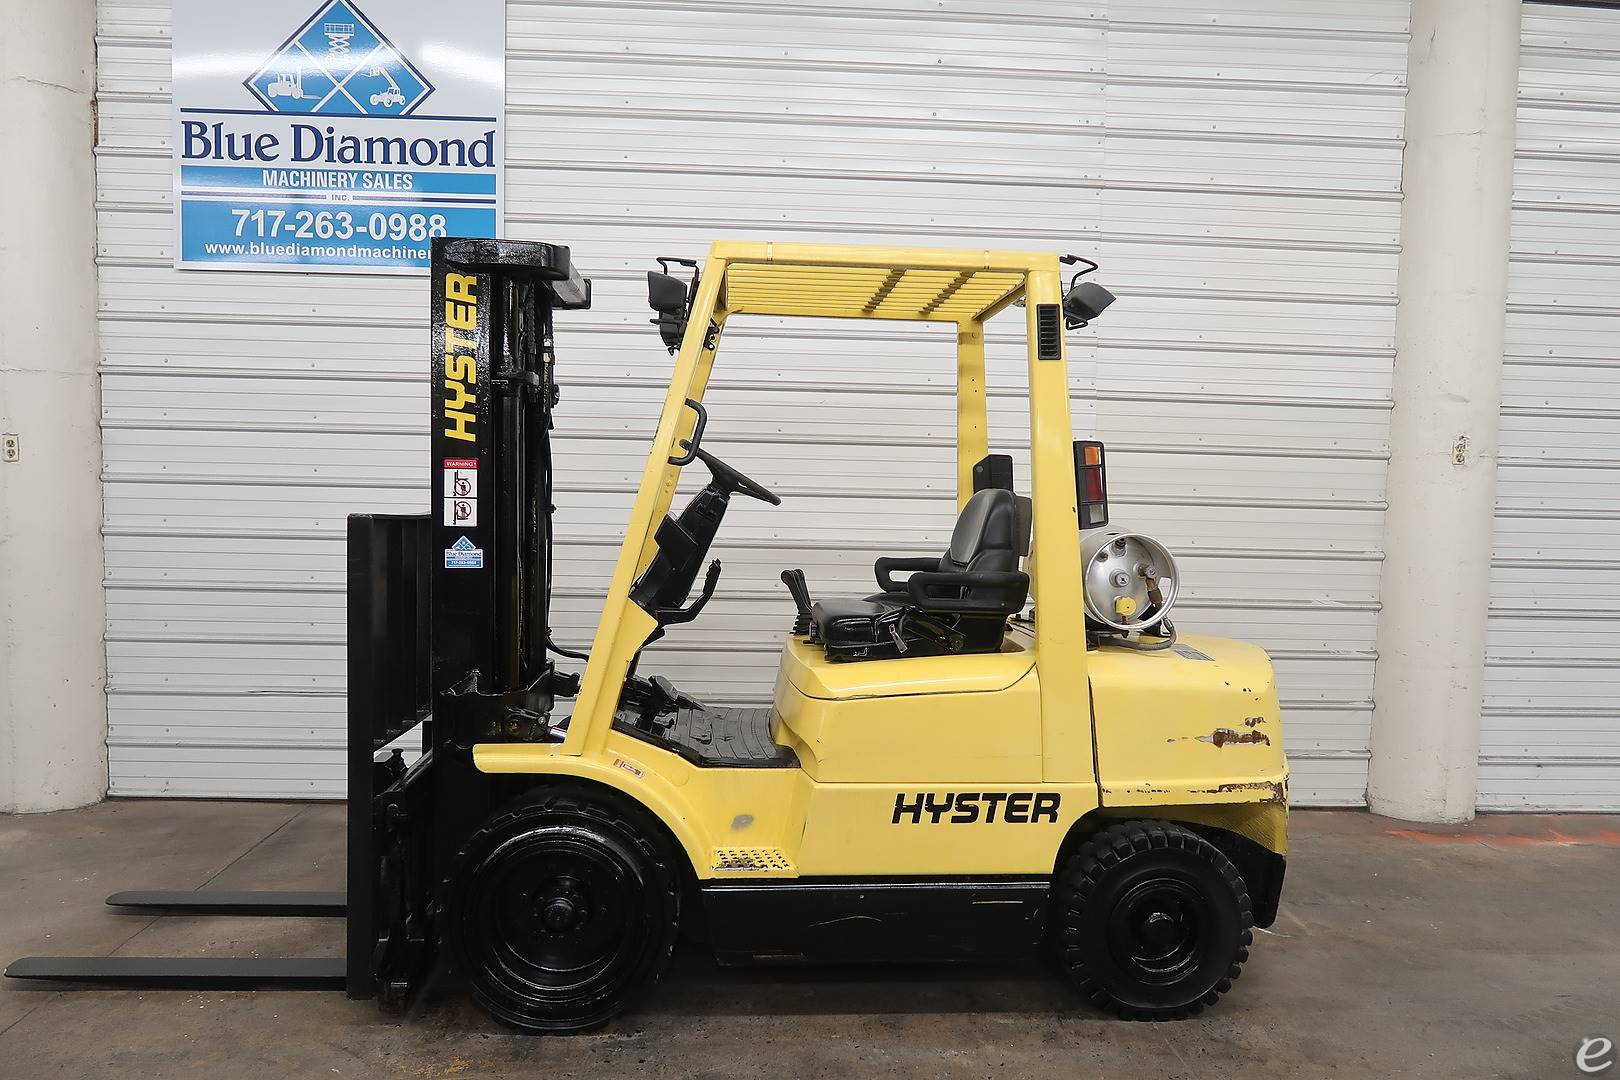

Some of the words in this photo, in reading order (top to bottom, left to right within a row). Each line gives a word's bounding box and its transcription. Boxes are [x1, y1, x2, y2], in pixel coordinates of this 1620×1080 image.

[181, 120, 279, 162] Blue
[290, 123, 495, 168] Diamond
[262, 169, 356, 189] MACHINERY
[362, 173, 413, 190] SALES
[231, 209, 447, 241] 717-263-0988
[445, 272, 478, 442] HYSTER
[892, 793, 1061, 824] HYSTER
